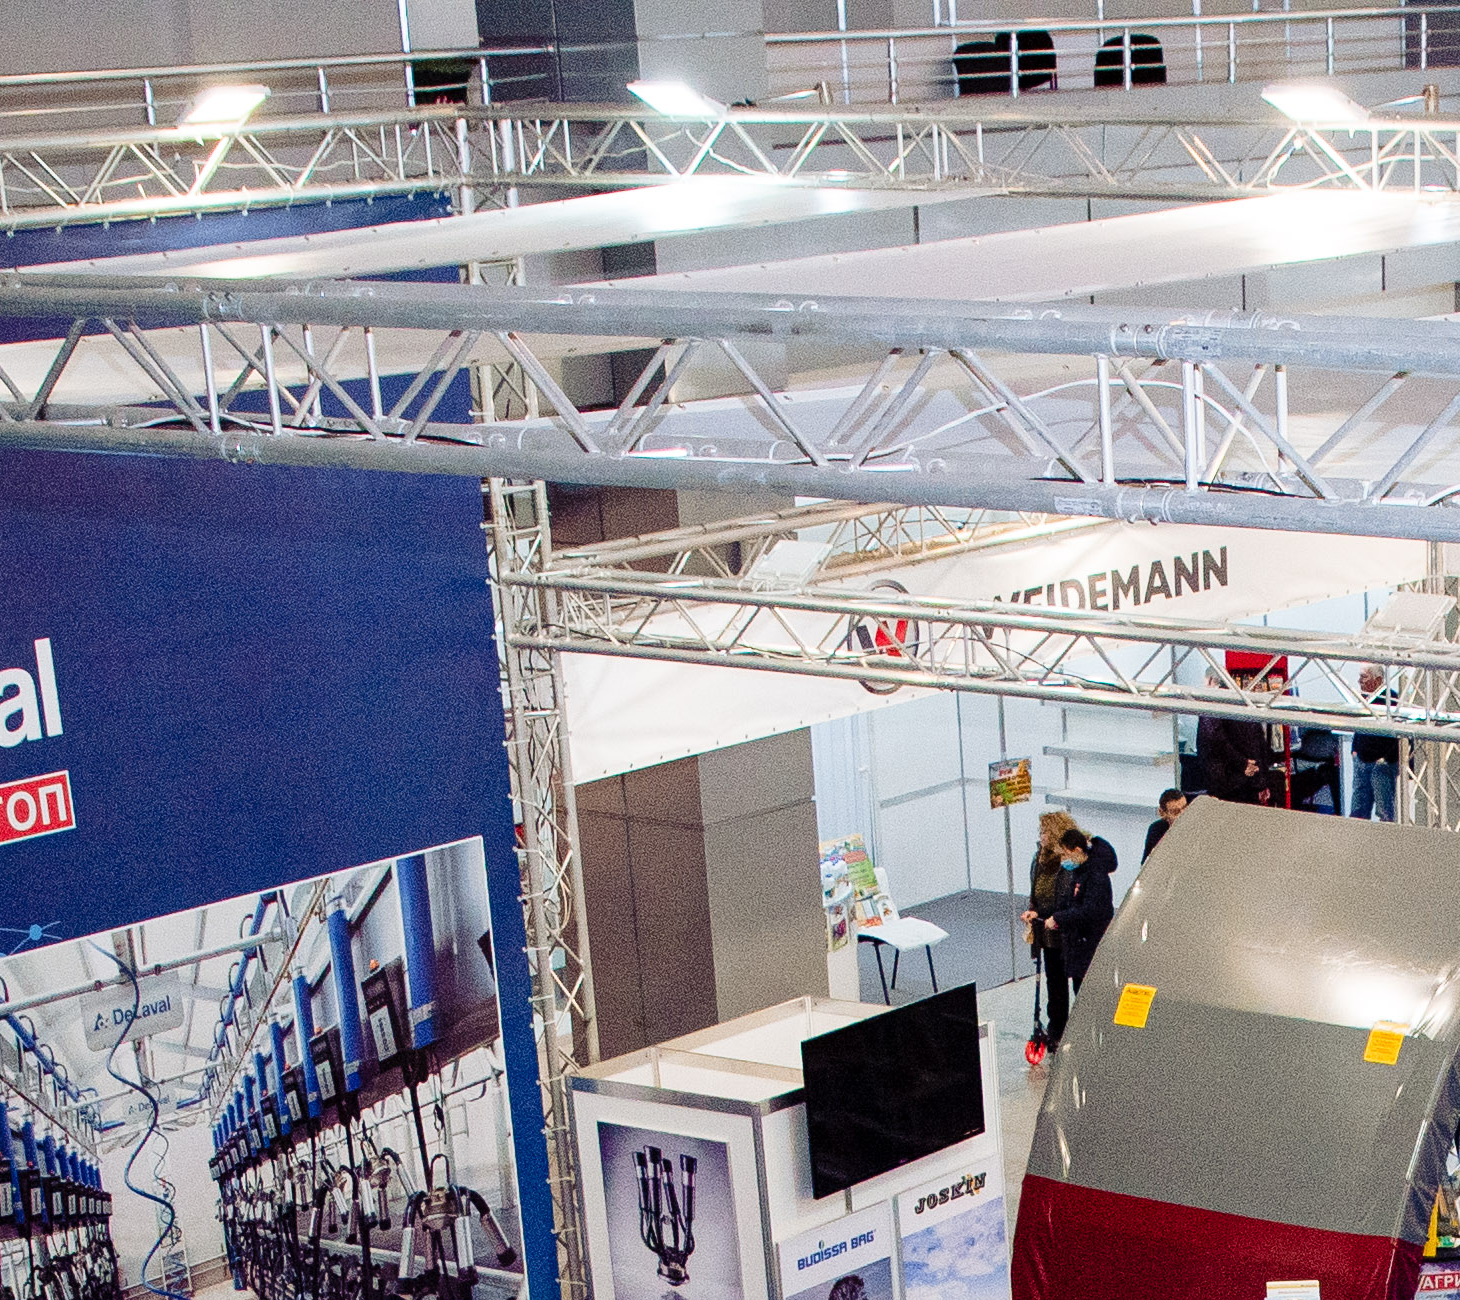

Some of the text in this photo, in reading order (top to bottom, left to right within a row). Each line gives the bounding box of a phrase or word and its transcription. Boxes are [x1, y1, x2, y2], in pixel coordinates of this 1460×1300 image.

[914, 1171, 987, 1215] JOSKIN
[796, 1229, 875, 1271] BUDISSA BAG
